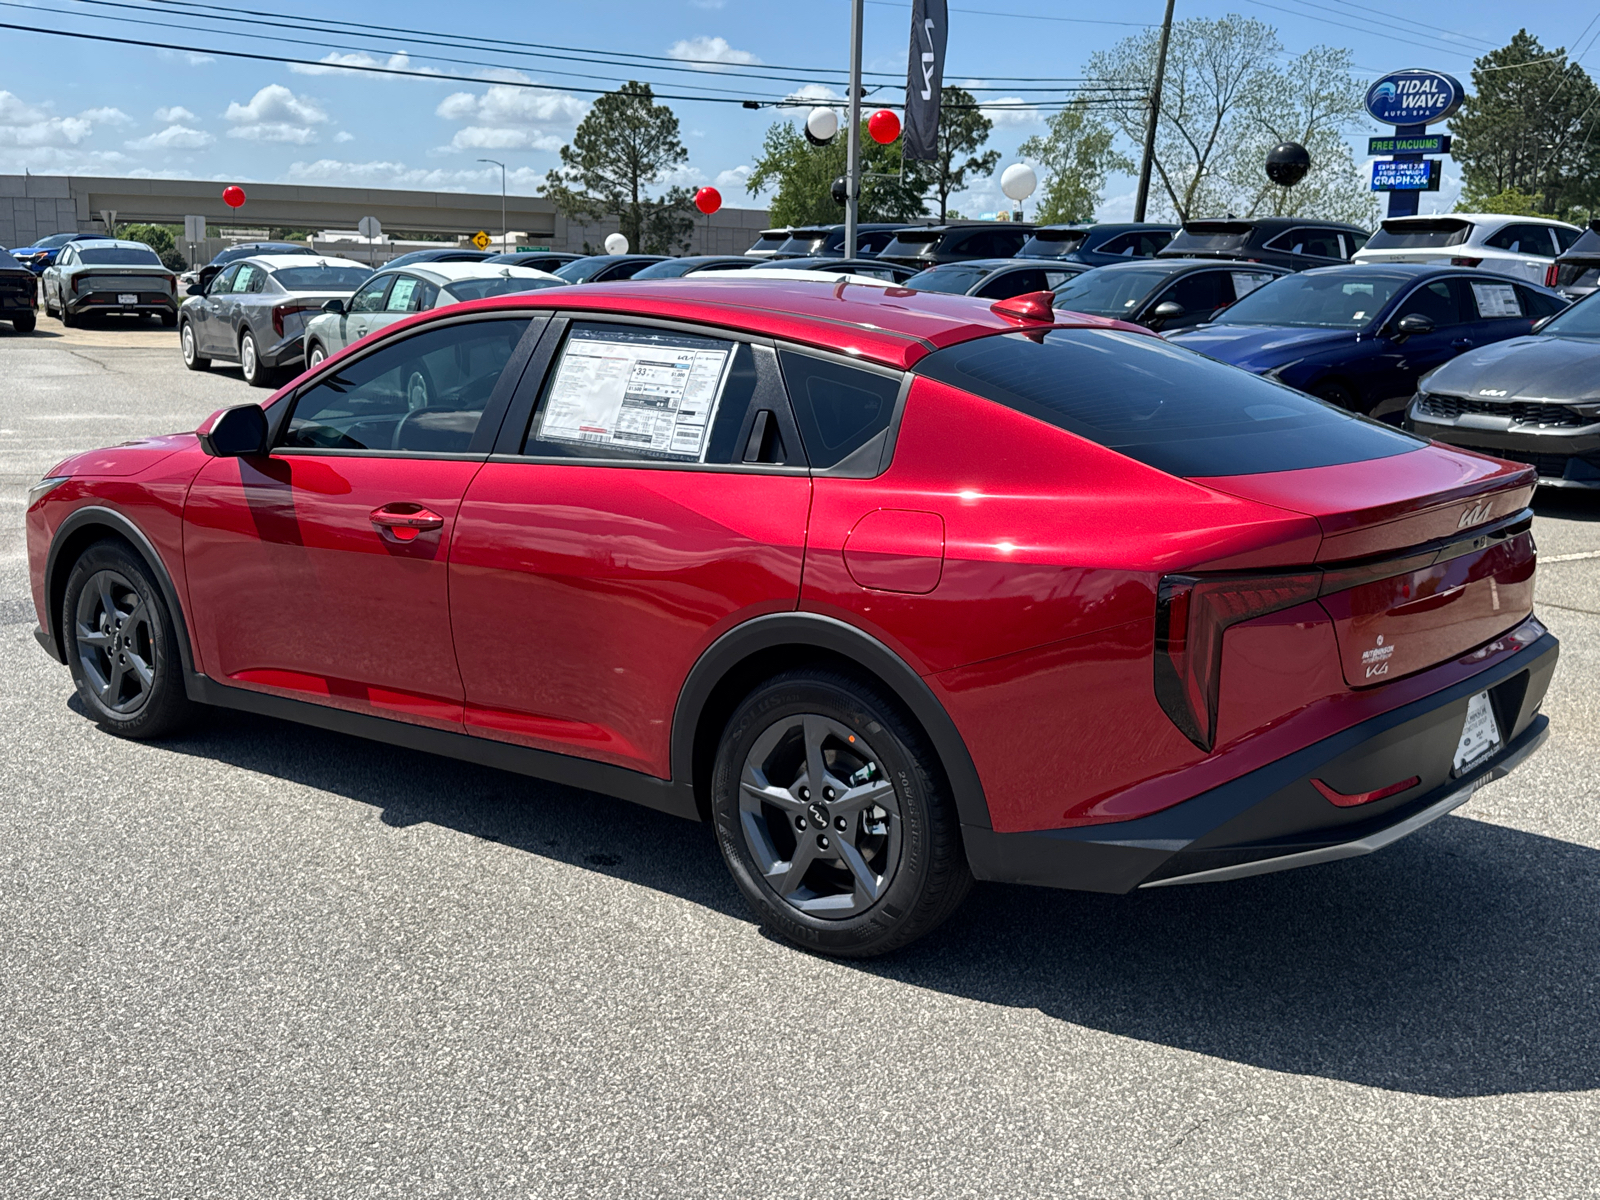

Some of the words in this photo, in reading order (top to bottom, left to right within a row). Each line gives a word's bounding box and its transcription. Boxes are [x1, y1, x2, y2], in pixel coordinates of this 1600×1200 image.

[1396, 79, 1438, 94] TIDAL
[1402, 93, 1447, 108] WAVE
[1371, 141, 1394, 151] FREE
[1396, 138, 1439, 150] VACUUMS
[636, 367, 647, 376] 33
[1458, 501, 1493, 528] KIA
[1365, 661, 1388, 678] K4
[733, 693, 782, 741] SOLUS
[898, 770, 916, 815] 205/55
[809, 805, 828, 827] KIA
[758, 898, 820, 943] KUMHO
